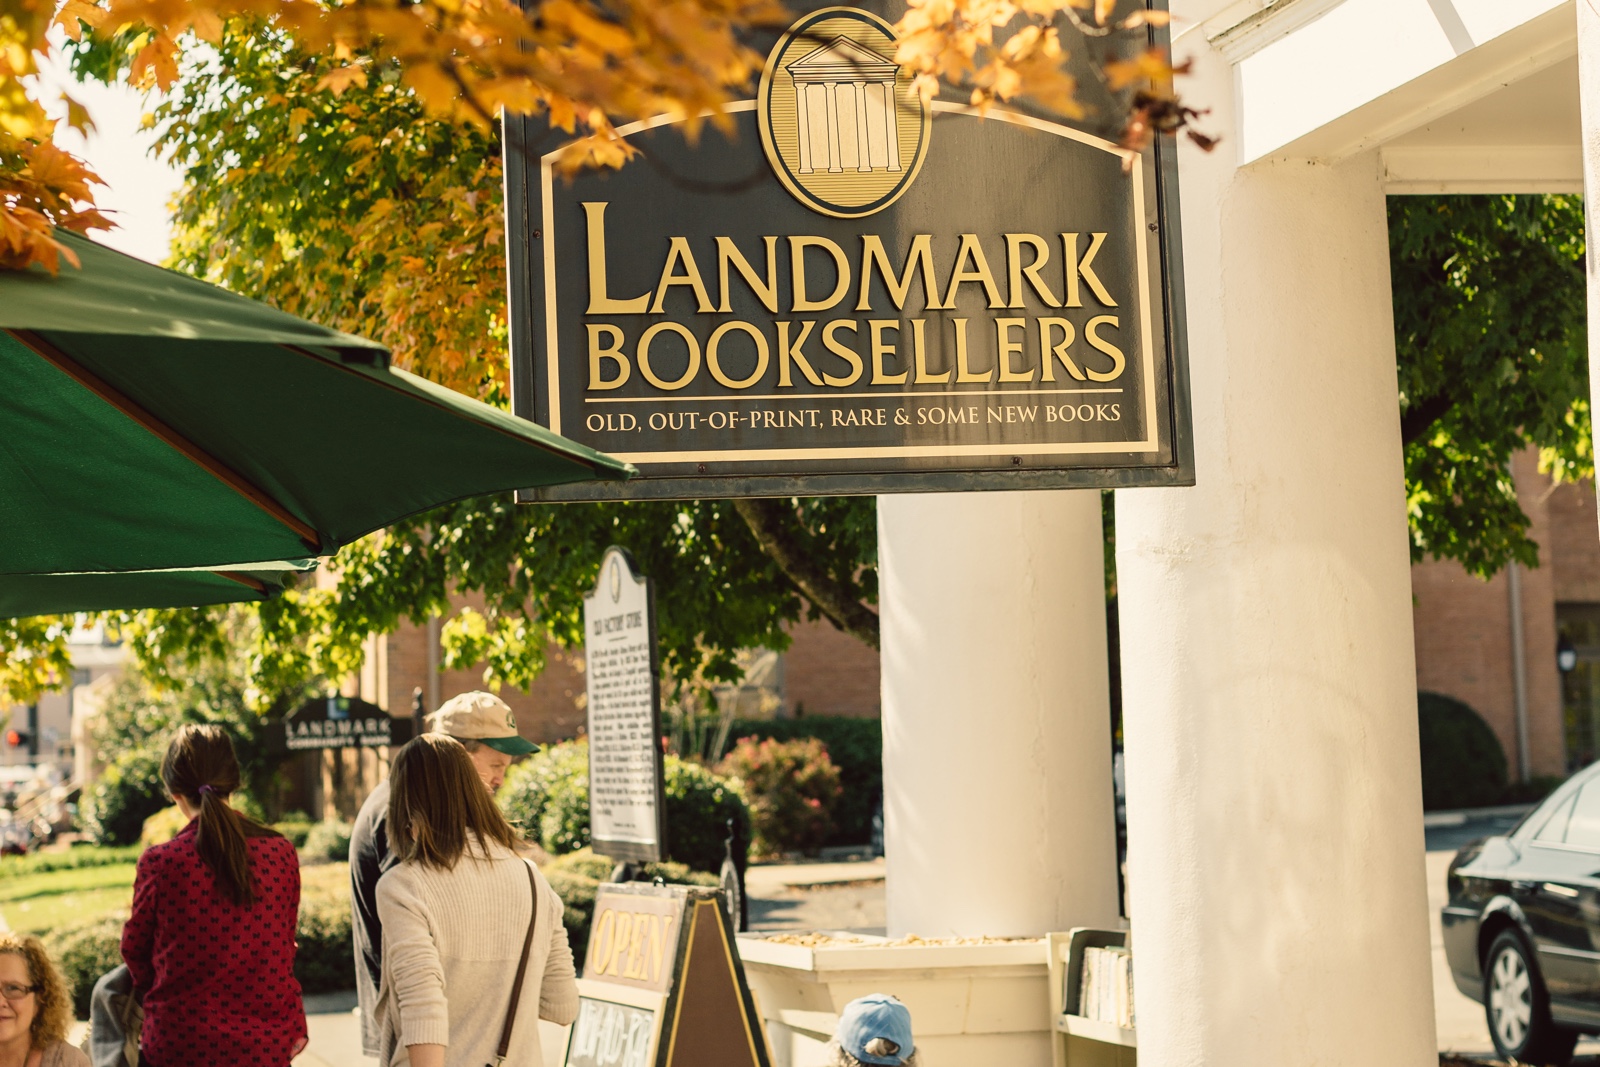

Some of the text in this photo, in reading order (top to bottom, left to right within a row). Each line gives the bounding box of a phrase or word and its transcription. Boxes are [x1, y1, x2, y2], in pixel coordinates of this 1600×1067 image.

[581, 202, 1118, 315] LANDMARK
[585, 315, 1127, 392] BOOKSELLERS
[586, 403, 1121, 433] OLD, OUT-OF-PRINT, RARE & SOME NEW BOOKS
[286, 719, 391, 737] LANDMARK
[593, 909, 673, 982] OPEN
